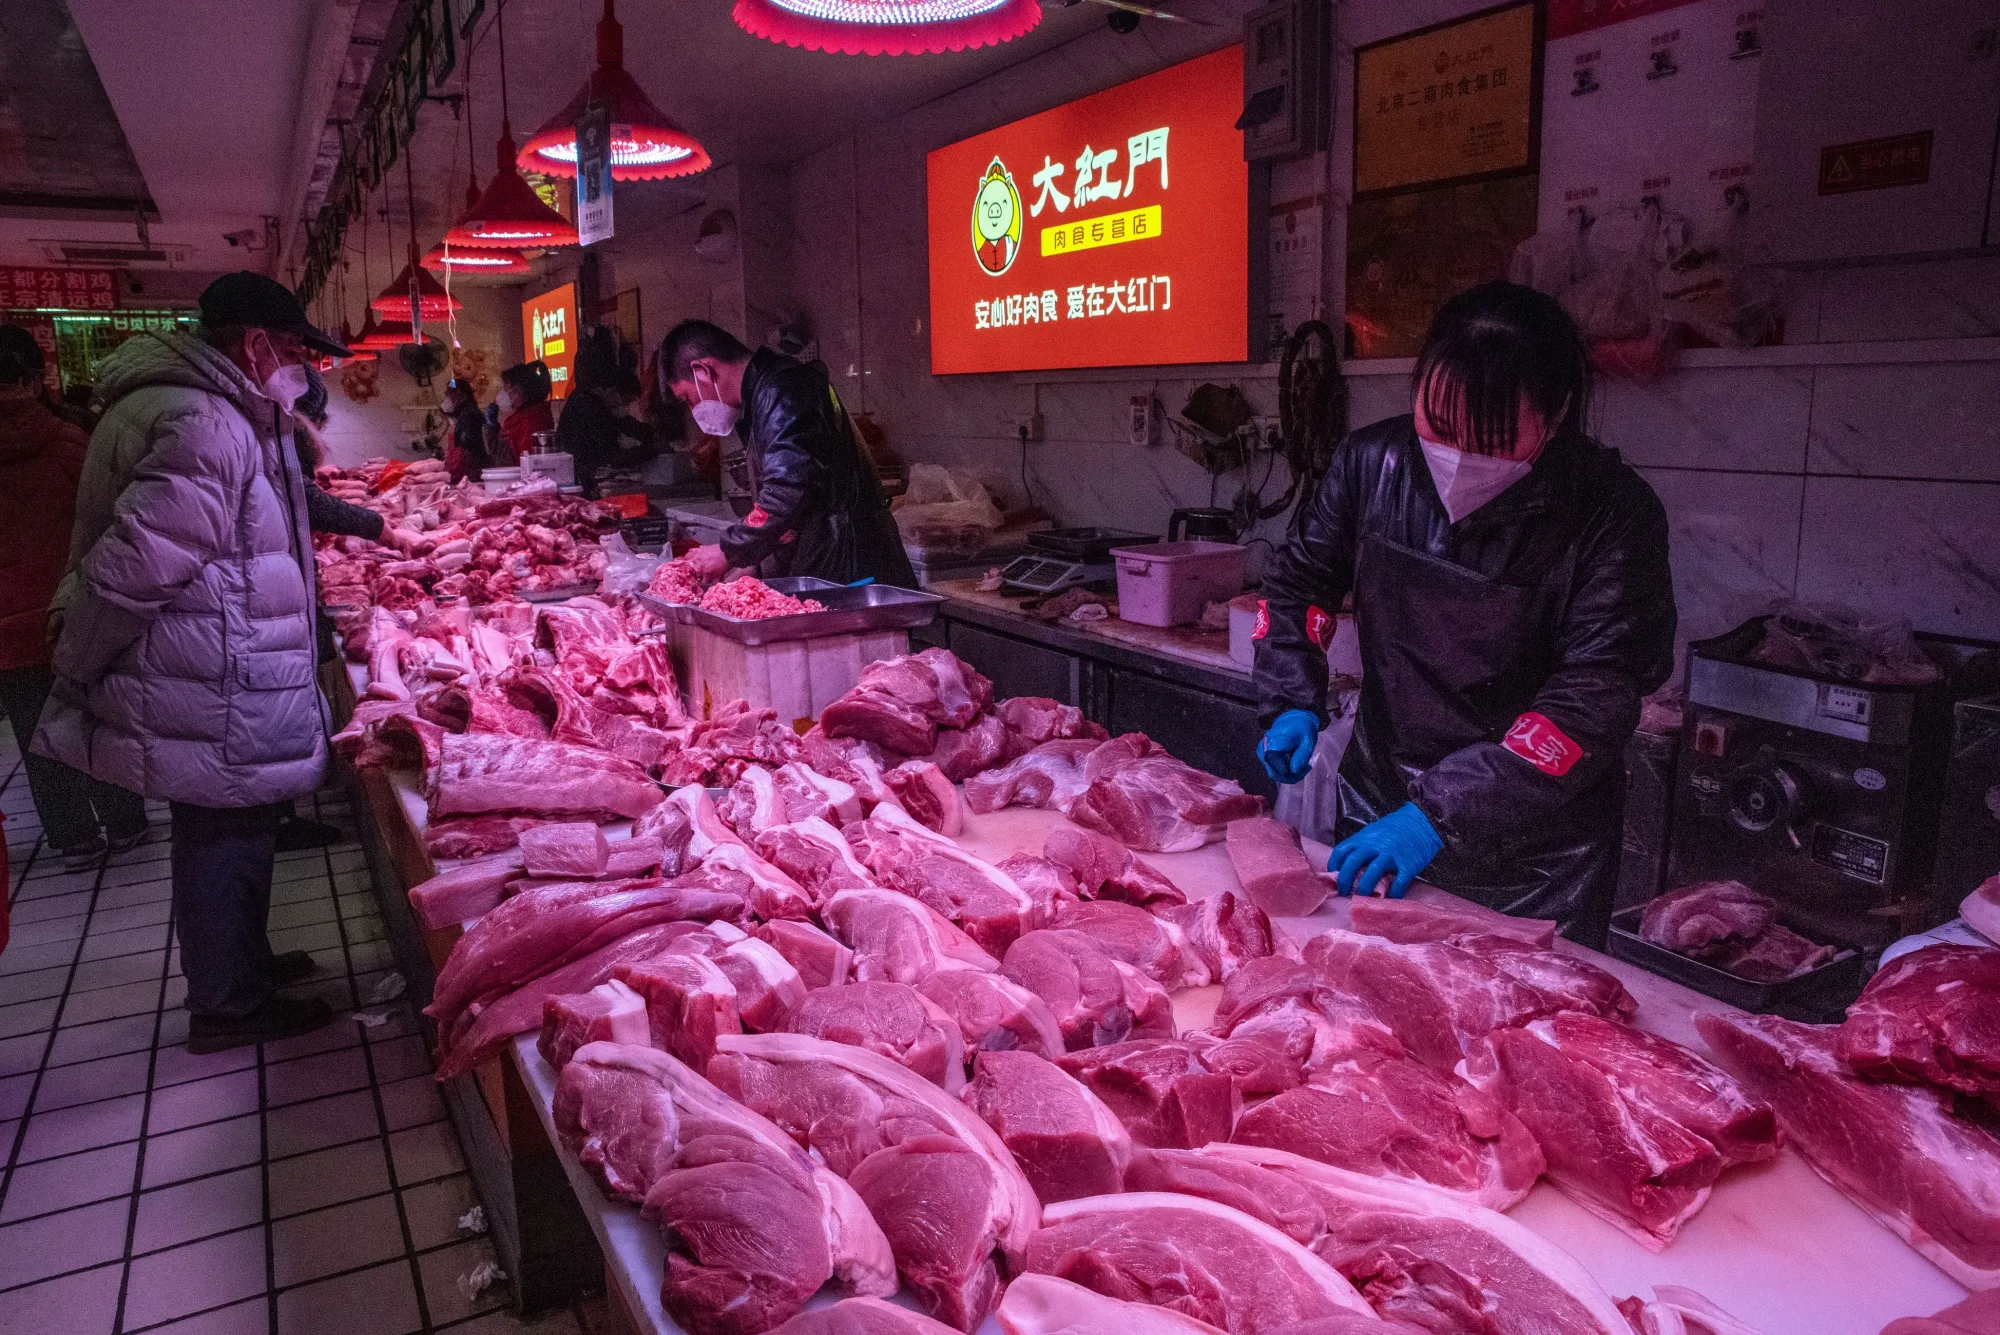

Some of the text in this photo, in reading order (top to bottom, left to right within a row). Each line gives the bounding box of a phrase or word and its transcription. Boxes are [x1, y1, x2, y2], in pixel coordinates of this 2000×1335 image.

[1376, 67, 1508, 115] 北京二商肉食集团
[1030, 127, 1170, 217] 大紅門
[1054, 214, 1148, 249] 肉食专营店
[974, 275, 1171, 330] 安心好肉食 爱在大红门
